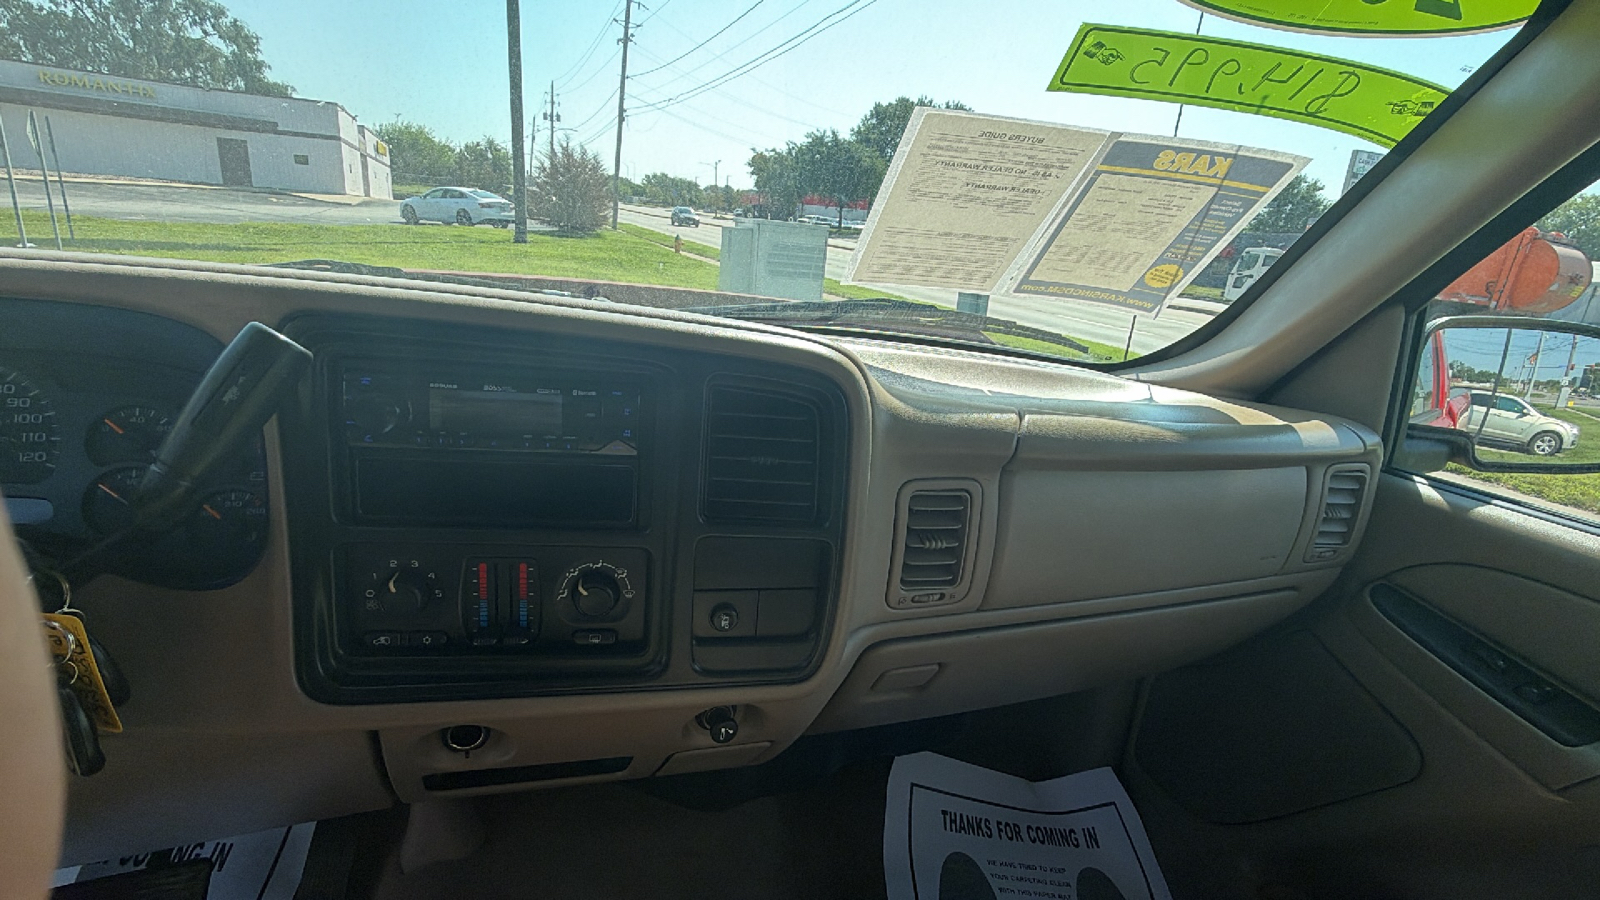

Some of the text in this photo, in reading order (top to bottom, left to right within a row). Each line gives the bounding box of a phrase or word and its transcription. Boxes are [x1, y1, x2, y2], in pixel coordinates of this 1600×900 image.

[39, 70, 157, 97] ROMANTIX
[7, 397, 30, 408] 90
[14, 413, 42, 424] 100
[20, 432, 46, 442] 110
[19, 451, 47, 462] 120
[389, 559, 419, 568] 2 3
[434, 590, 442, 598] 5
[941, 809, 1100, 850] THANKS FOR COMING IN
[210, 842, 234, 872] IN
[1000, 860, 1017, 868] HAVE
[1018, 862, 1037, 871] TRIED
[1050, 866, 1066, 874] KEEP
[990, 872, 1072, 888] YOUR CARPETING CLEAN
[998, 886, 1016, 894] WITH
[1033, 891, 1056, 899] PAPER
